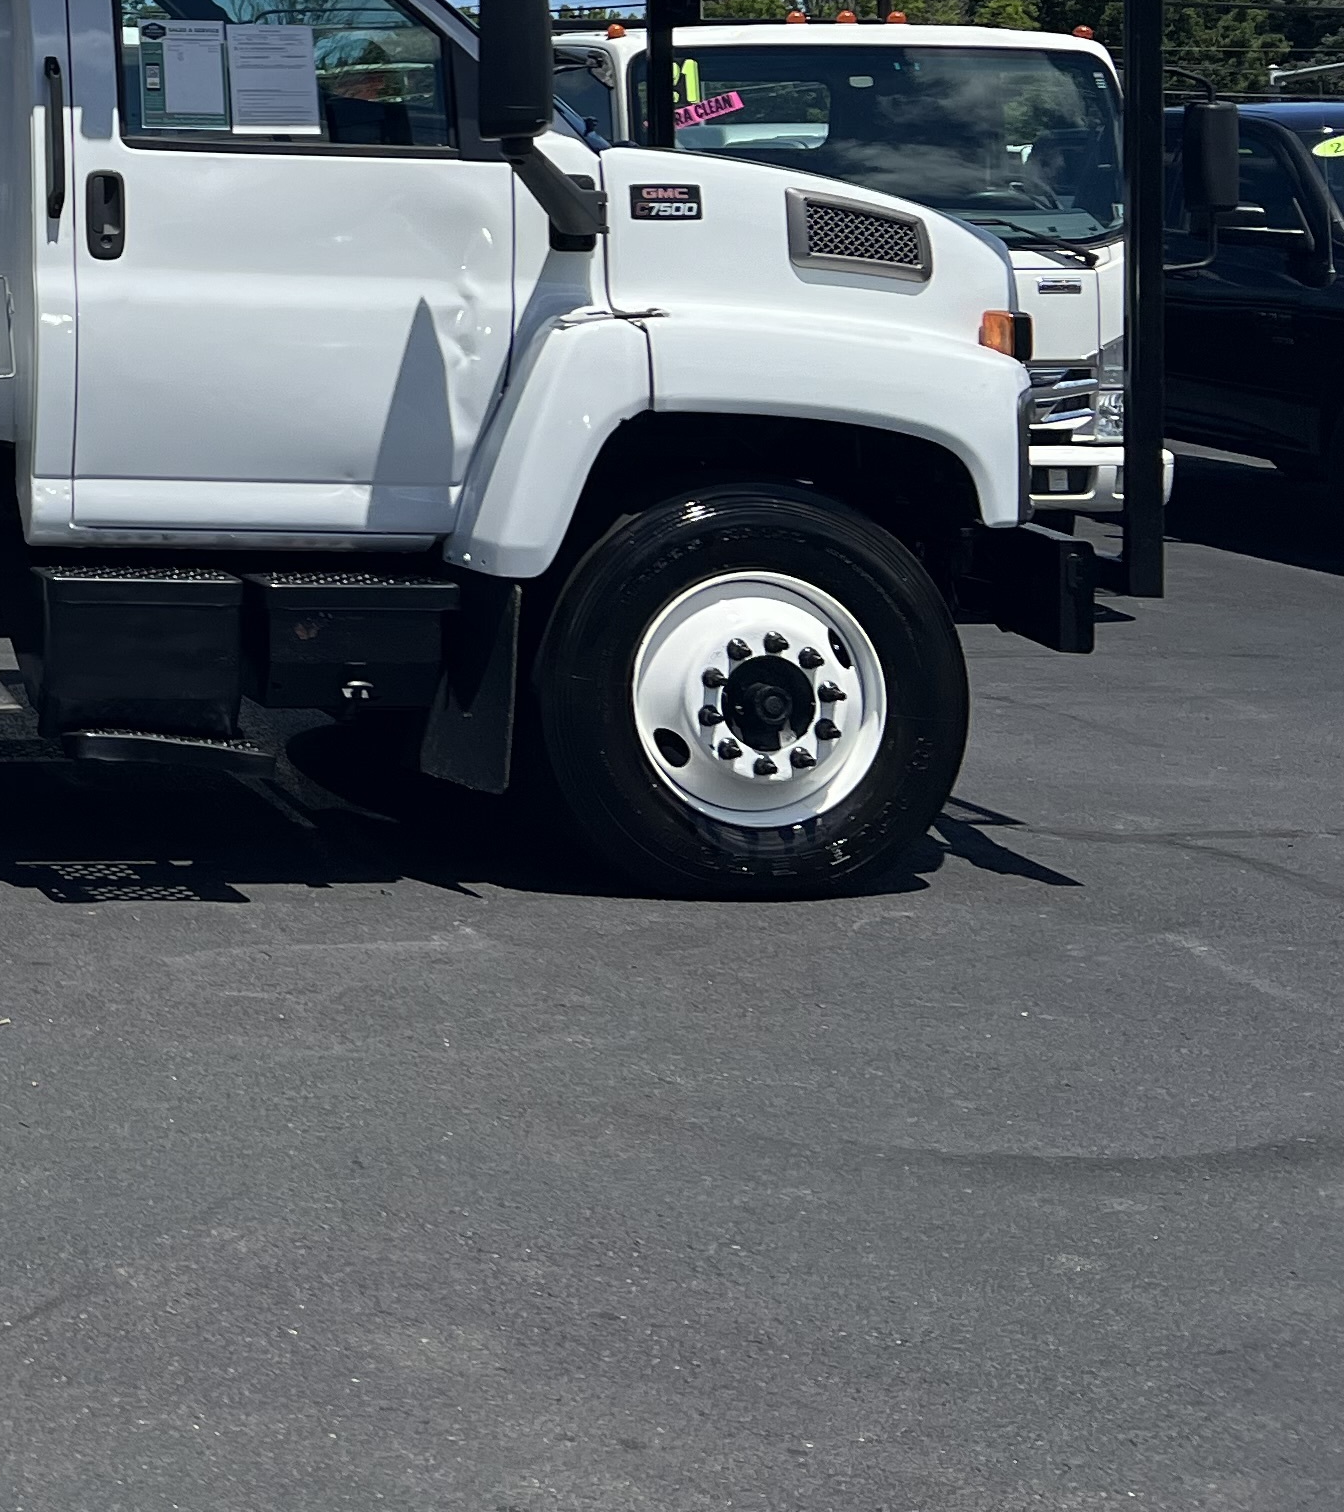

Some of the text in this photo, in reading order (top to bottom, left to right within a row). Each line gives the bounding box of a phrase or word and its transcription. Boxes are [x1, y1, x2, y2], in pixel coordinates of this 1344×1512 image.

[693, 94, 734, 120] CLEAN
[641, 187, 689, 199] GMC
[635, 202, 699, 216] C7500
